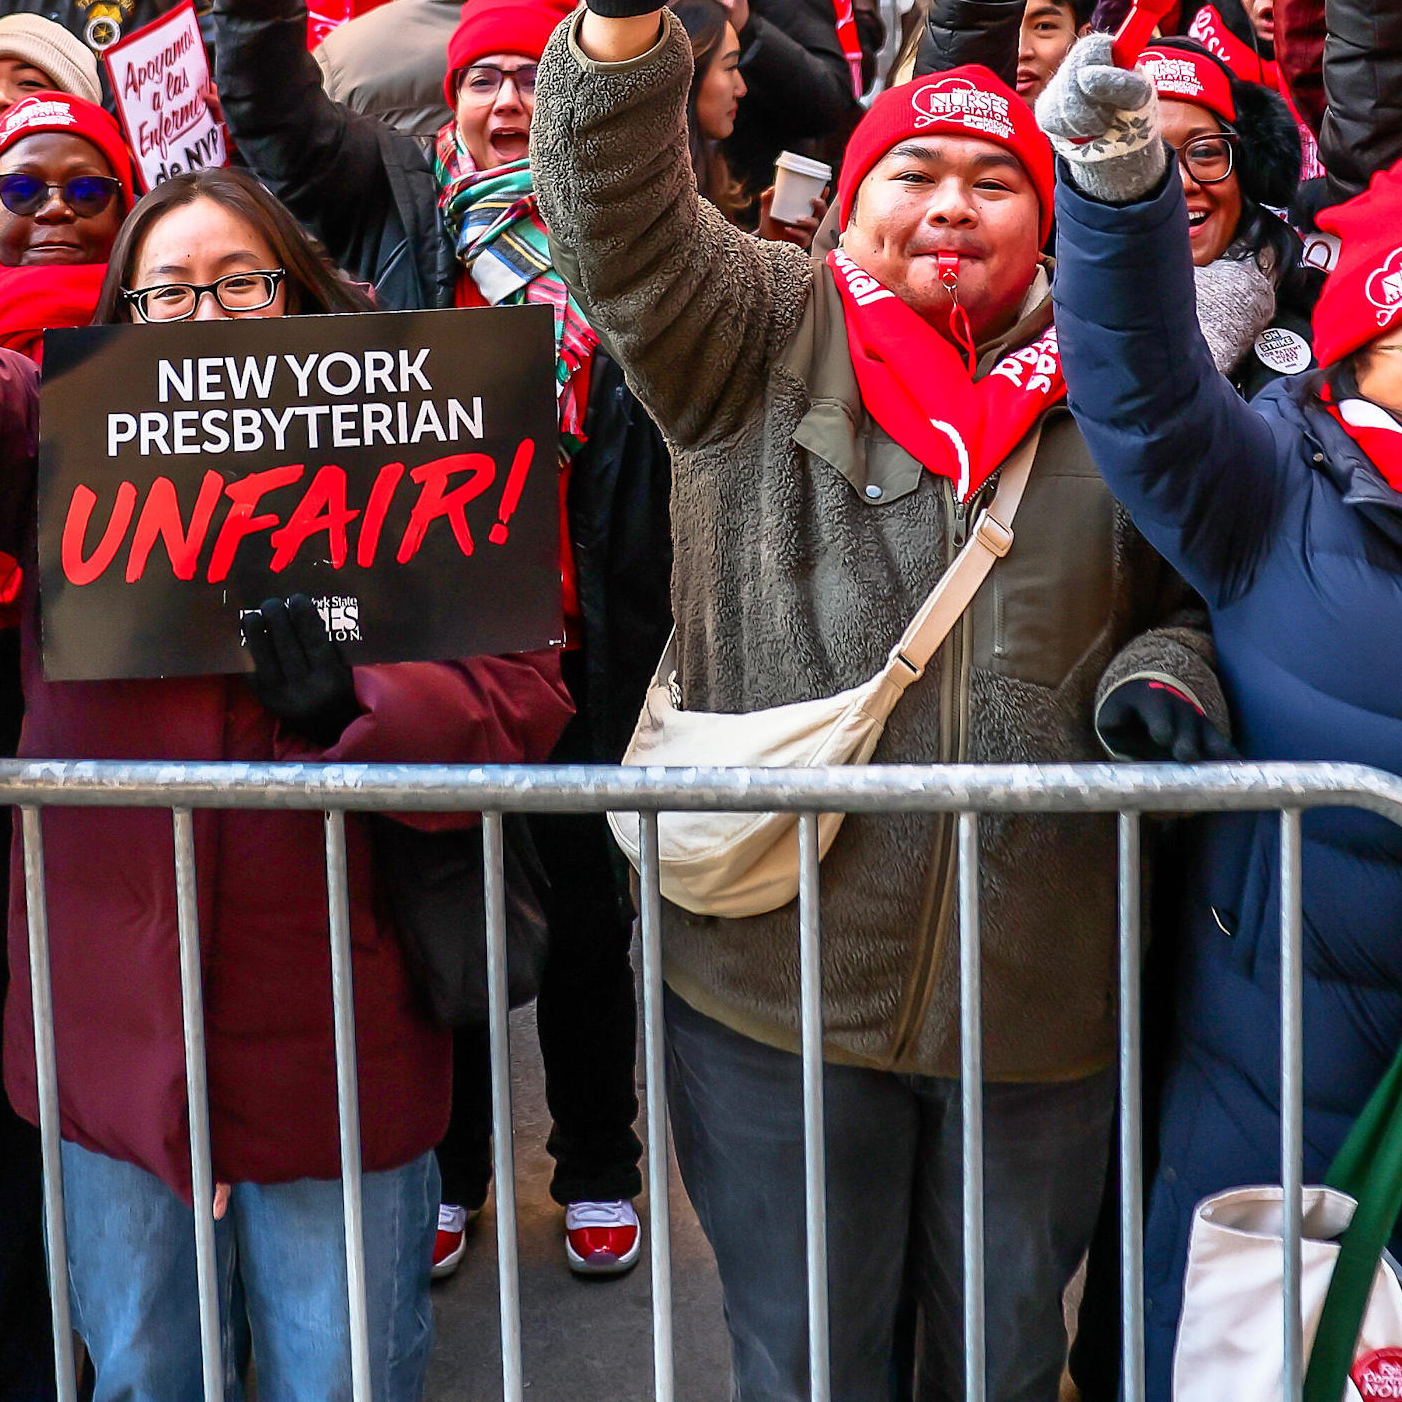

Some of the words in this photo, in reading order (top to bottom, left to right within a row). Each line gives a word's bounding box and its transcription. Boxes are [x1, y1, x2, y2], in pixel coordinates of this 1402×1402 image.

[929, 92, 1009, 117] NURSES
[1259, 336, 1294, 351] STRIKE
[1263, 329, 1279, 341] ON
[157, 354, 278, 402] NEW
[283, 347, 434, 396] YORK
[106, 396, 484, 457] PRESBYTERIAN
[60, 437, 535, 586] UNFAIR!
